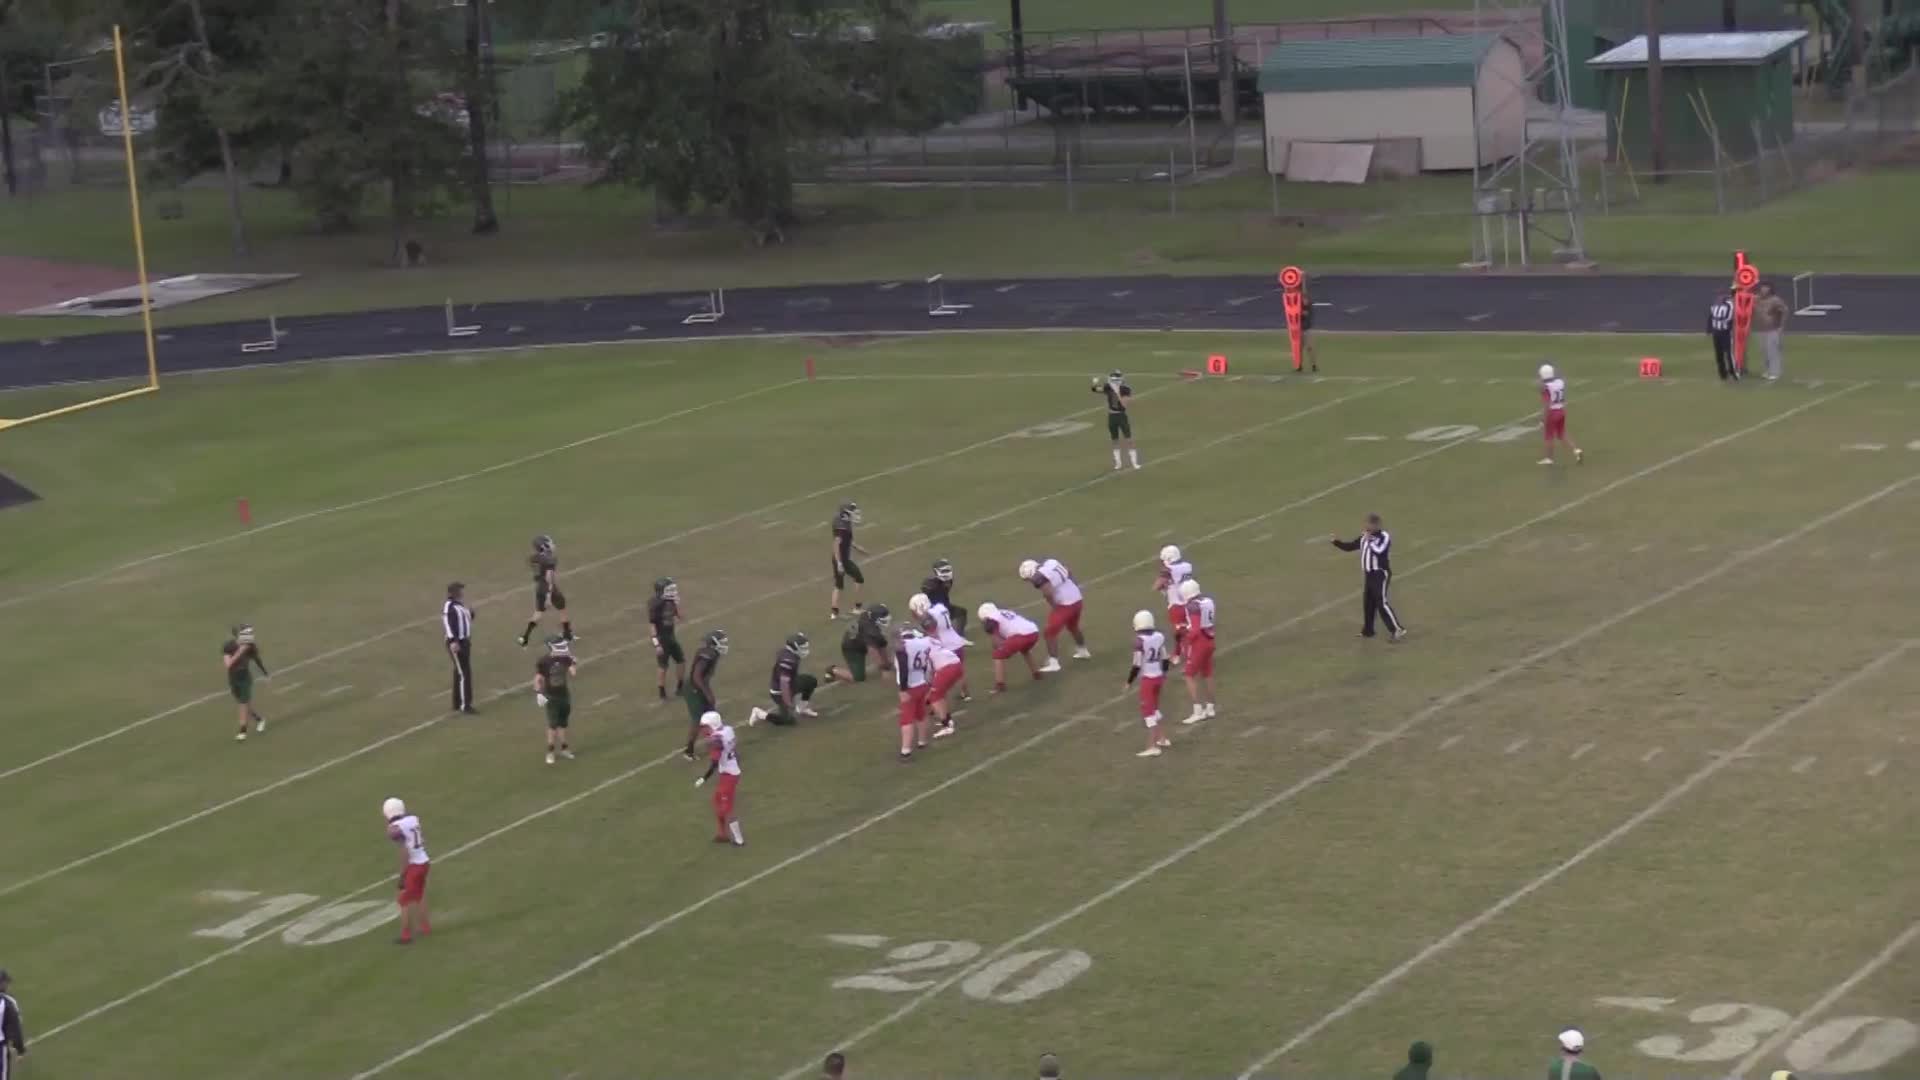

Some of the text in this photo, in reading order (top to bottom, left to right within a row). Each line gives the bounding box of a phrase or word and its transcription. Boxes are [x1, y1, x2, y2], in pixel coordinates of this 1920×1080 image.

[1641, 361, 1659, 376] 10
[190, 892, 402, 946] 10
[829, 939, 1093, 1003] 20
[1632, 1002, 1920, 1074] 30
